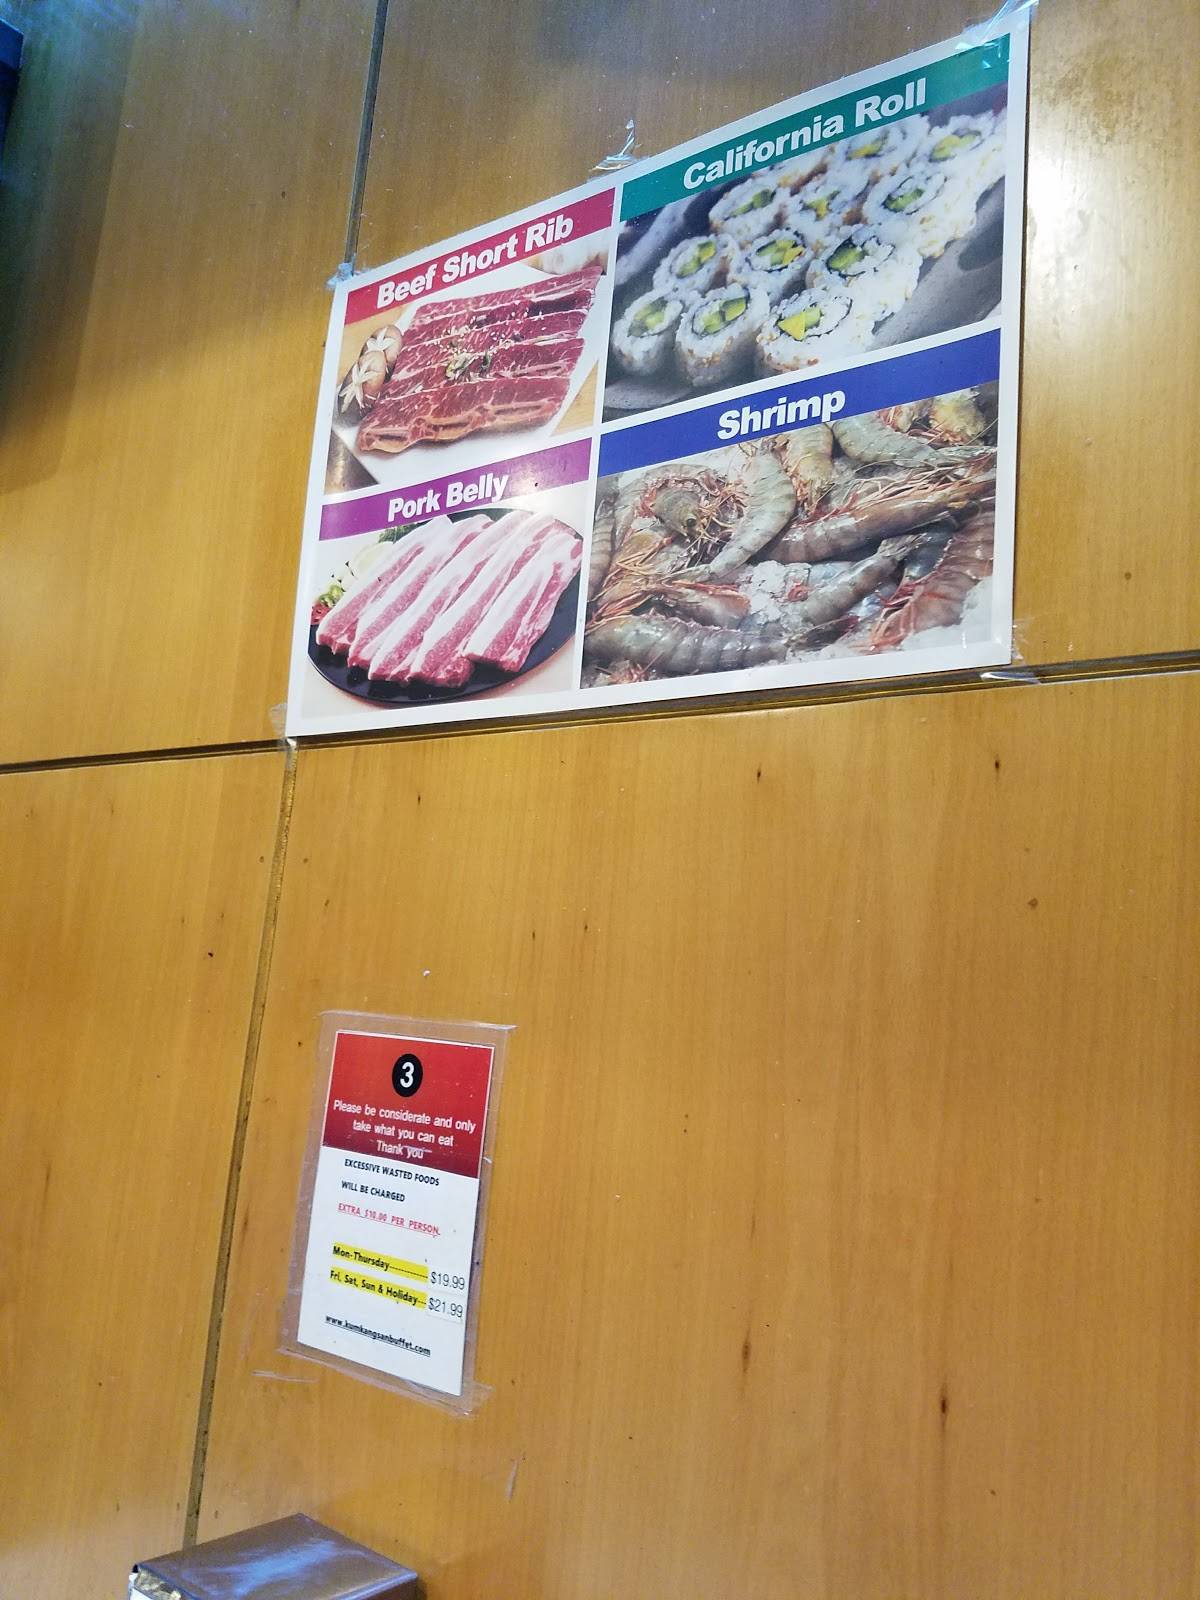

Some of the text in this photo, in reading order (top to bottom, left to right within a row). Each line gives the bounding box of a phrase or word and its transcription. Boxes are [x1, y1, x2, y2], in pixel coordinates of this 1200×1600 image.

[683, 77, 927, 190] California Roll
[376, 214, 574, 309] Beef Short Rib
[717, 389, 846, 441] Shrimp
[387, 473, 509, 523] Pork Belly
[400, 1062, 415, 1088] 3
[333, 1099, 477, 1135] Please be considerate and only
[352, 1119, 454, 1147] take what you can eat
[376, 1140, 424, 1159] Thank you
[344, 1158, 440, 1186] EXCESSIVE WASTED FOODS
[341, 1180, 406, 1202] WILL BE CHARGED
[338, 1202, 361, 1216] EXTRA
[365, 1209, 388, 1222] $10.00
[391, 1215, 405, 1226] PER
[430, 1271, 466, 1291] $19.99
[361, 1279, 376, 1291] Sun
[378, 1284, 384, 1294] &
[428, 1296, 464, 1319] $21.99
[326, 1315, 431, 1357] www.kumkangsanbuffet.com
